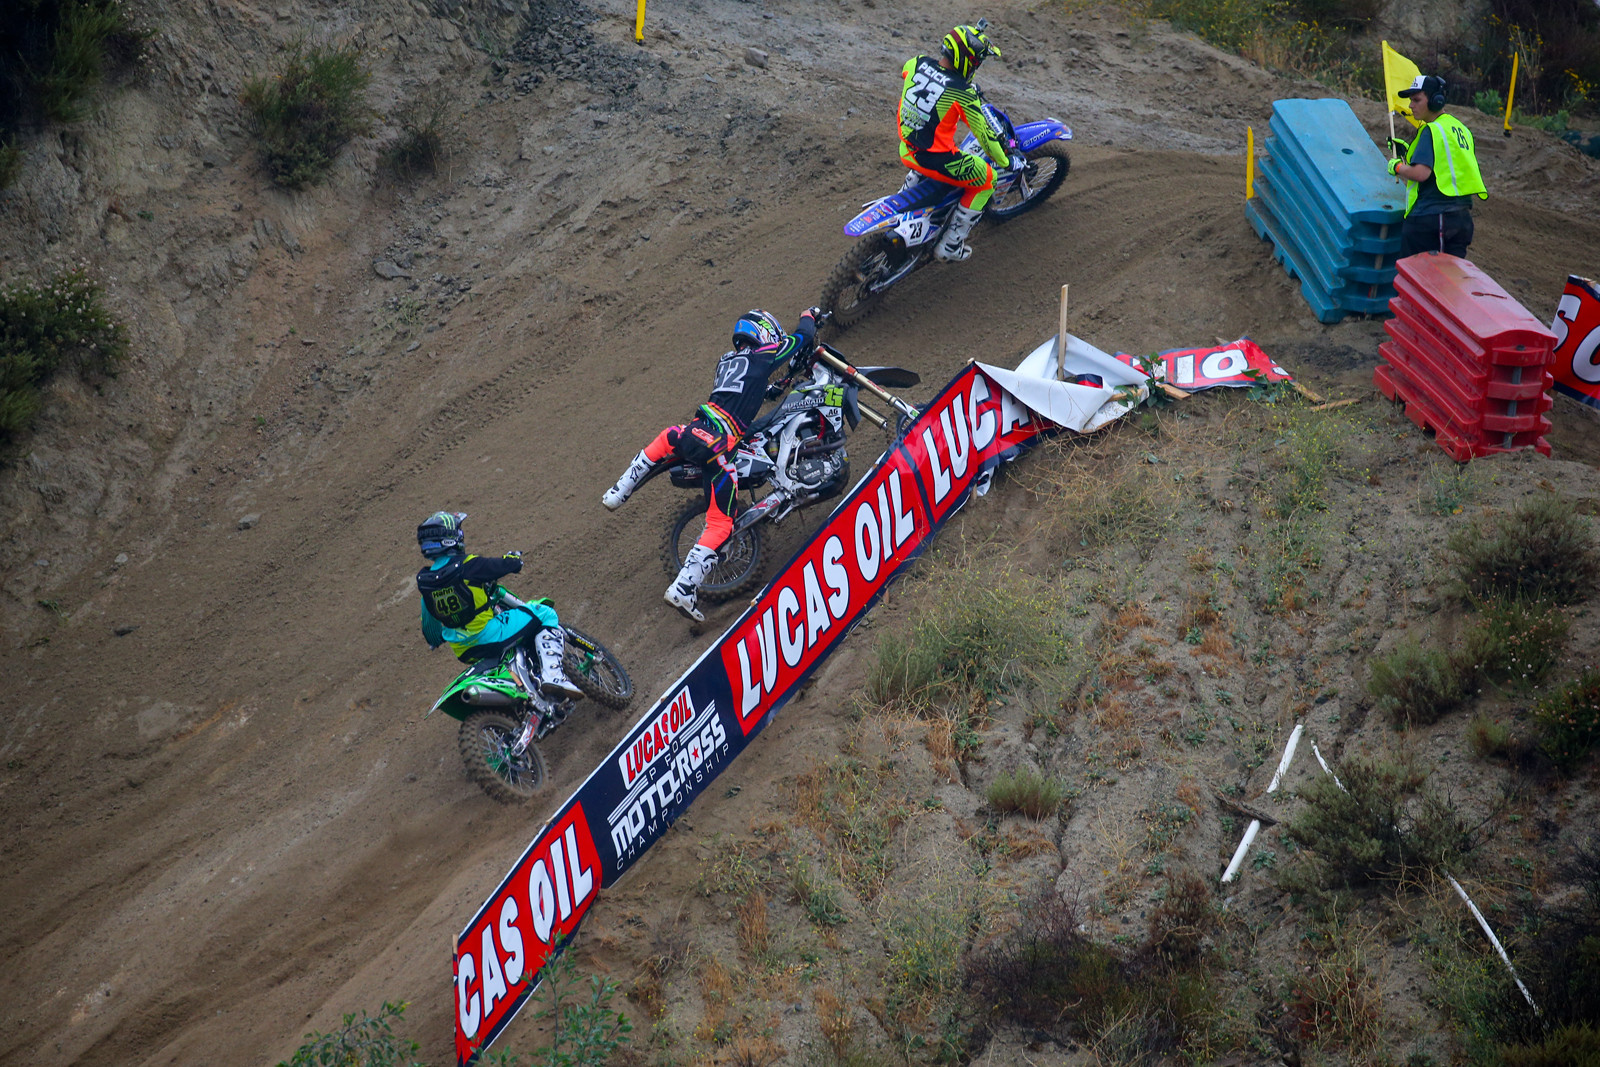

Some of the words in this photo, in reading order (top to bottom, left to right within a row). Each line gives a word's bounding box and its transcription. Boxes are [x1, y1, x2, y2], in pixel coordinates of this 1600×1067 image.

[918, 62, 951, 86] PEICK
[905, 73, 945, 113] 23
[1029, 128, 1051, 144] TOYOTA
[1452, 126, 1470, 151] 26
[909, 221, 923, 240] 23
[436, 594, 462, 616] 48
[736, 534, 850, 720] LUCAS
[854, 467, 915, 583] OIL
[626, 713, 670, 784] LUCAS
[670, 690, 692, 733] OIL
[457, 895, 525, 1039] CAS
[528, 820, 594, 944] OIL
